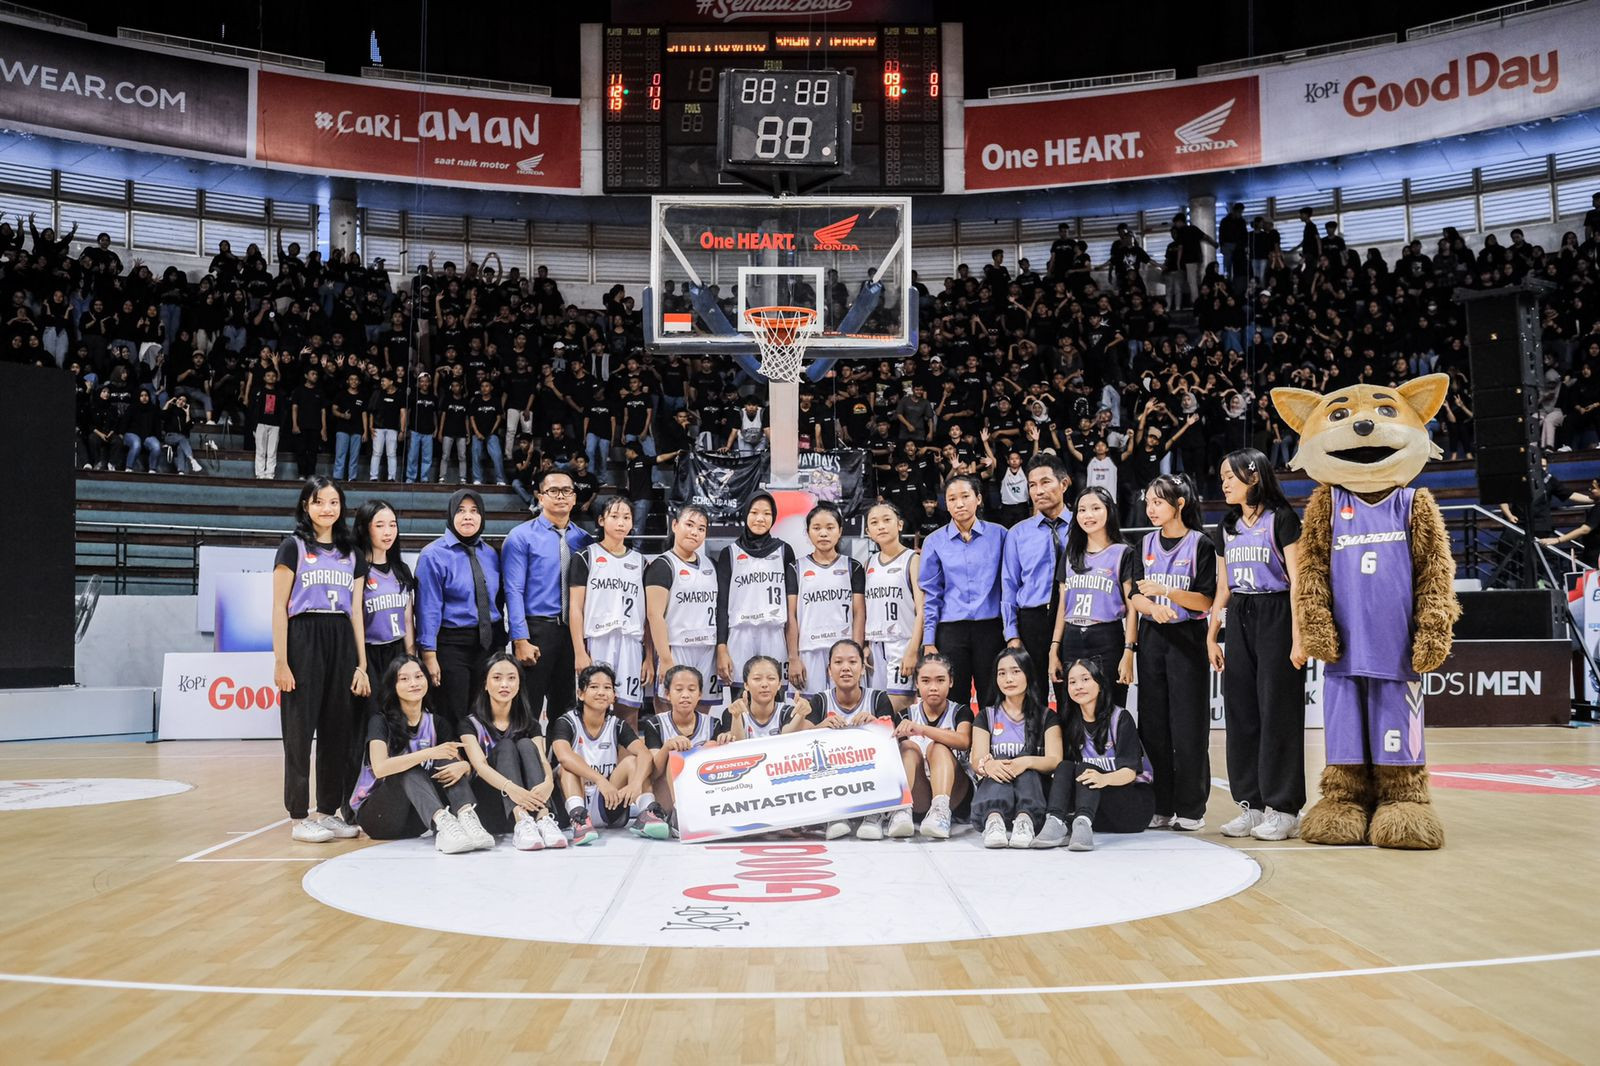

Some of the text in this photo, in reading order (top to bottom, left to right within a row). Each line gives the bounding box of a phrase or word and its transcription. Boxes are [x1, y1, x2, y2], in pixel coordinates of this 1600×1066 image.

[884, 73, 899, 85] 09
[1343, 59, 1458, 118] Good
[1467, 49, 1558, 94] Day
[610, 86, 622, 97] 12
[610, 98, 622, 109] 13
[981, 131, 1144, 171] One HEART.
[1175, 138, 1238, 154] HONDA
[434, 157, 510, 170] saat naik motor
[700, 231, 796, 250] One HEART.
[1361, 551, 1377, 574] 6
[766, 586, 782, 605] 13
[1073, 593, 1093, 617] 28
[707, 606, 717, 626] 2
[841, 604, 849, 623] 7
[885, 601, 898, 621] 19
[626, 676, 640, 696] 12
[1476, 671, 1541, 696] MEN
[208, 676, 281, 711] Goo
[1384, 730, 1401, 752] 6
[715, 761, 751, 770] HONDA
[784, 752, 810, 761] EAST
[717, 771, 734, 780] DBL
[710, 781, 875, 816] FANTASTIC FOUR
